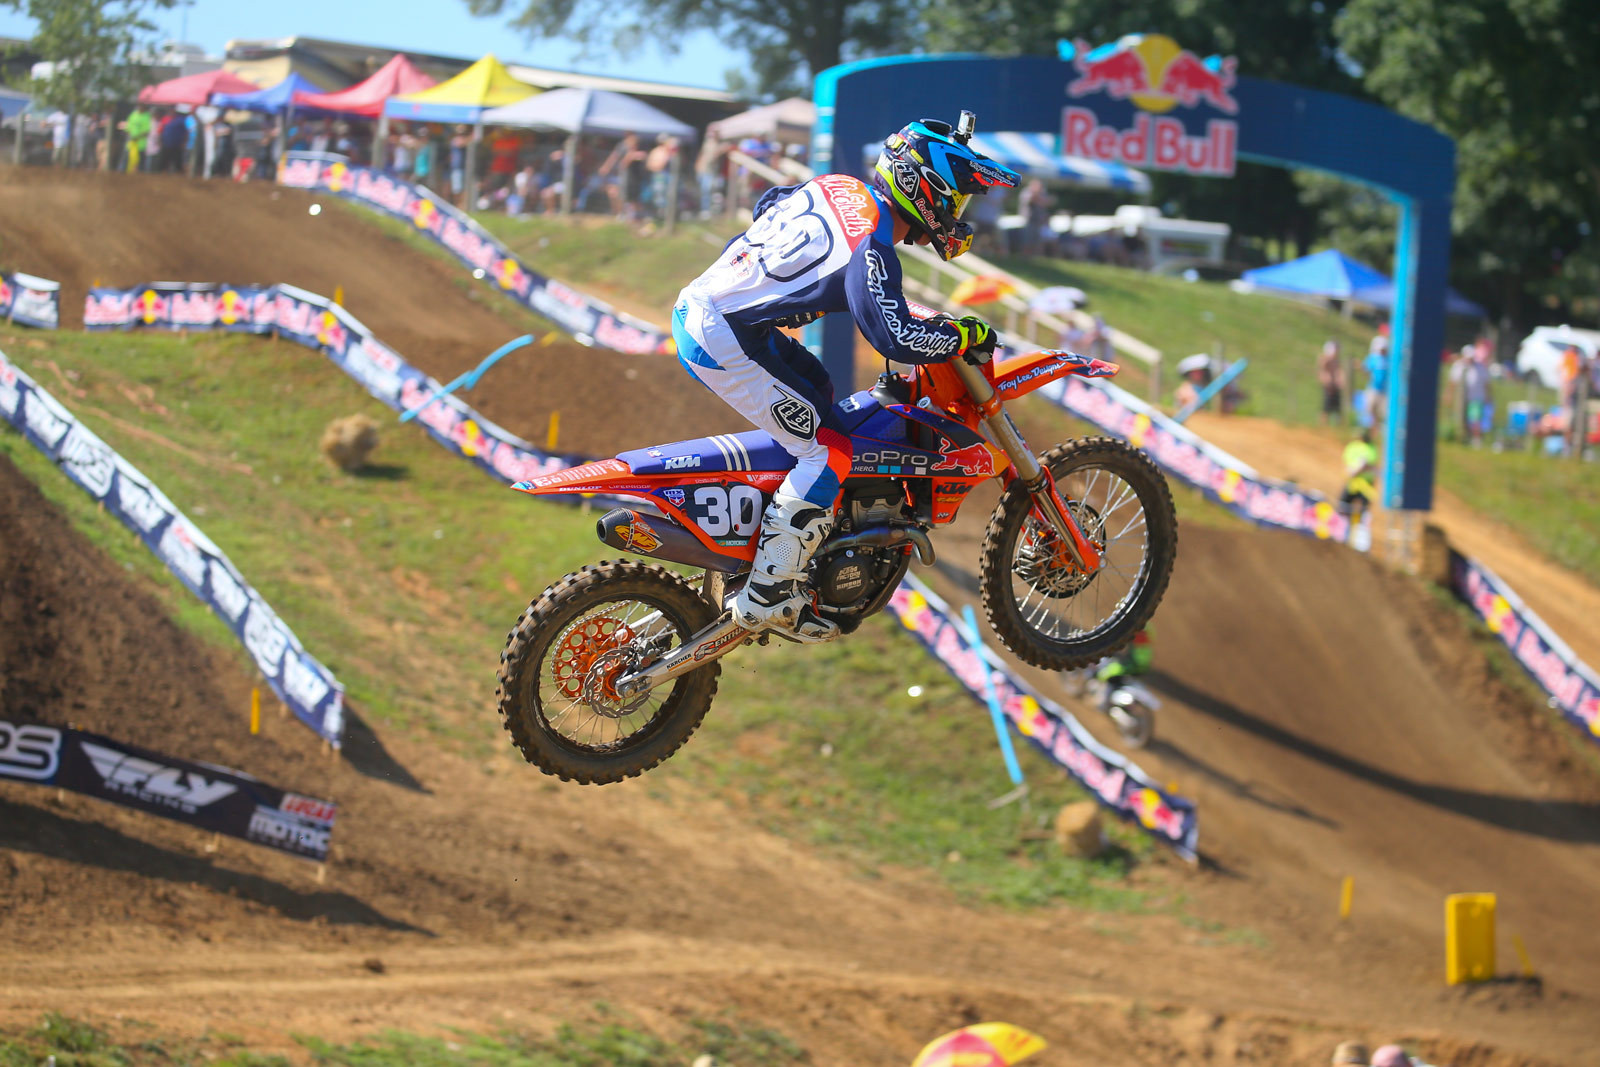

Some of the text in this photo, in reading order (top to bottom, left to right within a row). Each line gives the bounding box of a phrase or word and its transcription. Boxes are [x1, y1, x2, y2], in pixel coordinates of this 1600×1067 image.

[1062, 106, 1238, 178] Red Bull
[998, 361, 1067, 391] Troy Lee Designs
[664, 454, 701, 470] KTM
[935, 481, 974, 495] KTM
[693, 485, 763, 537] 30
[80, 741, 239, 807] FLY
